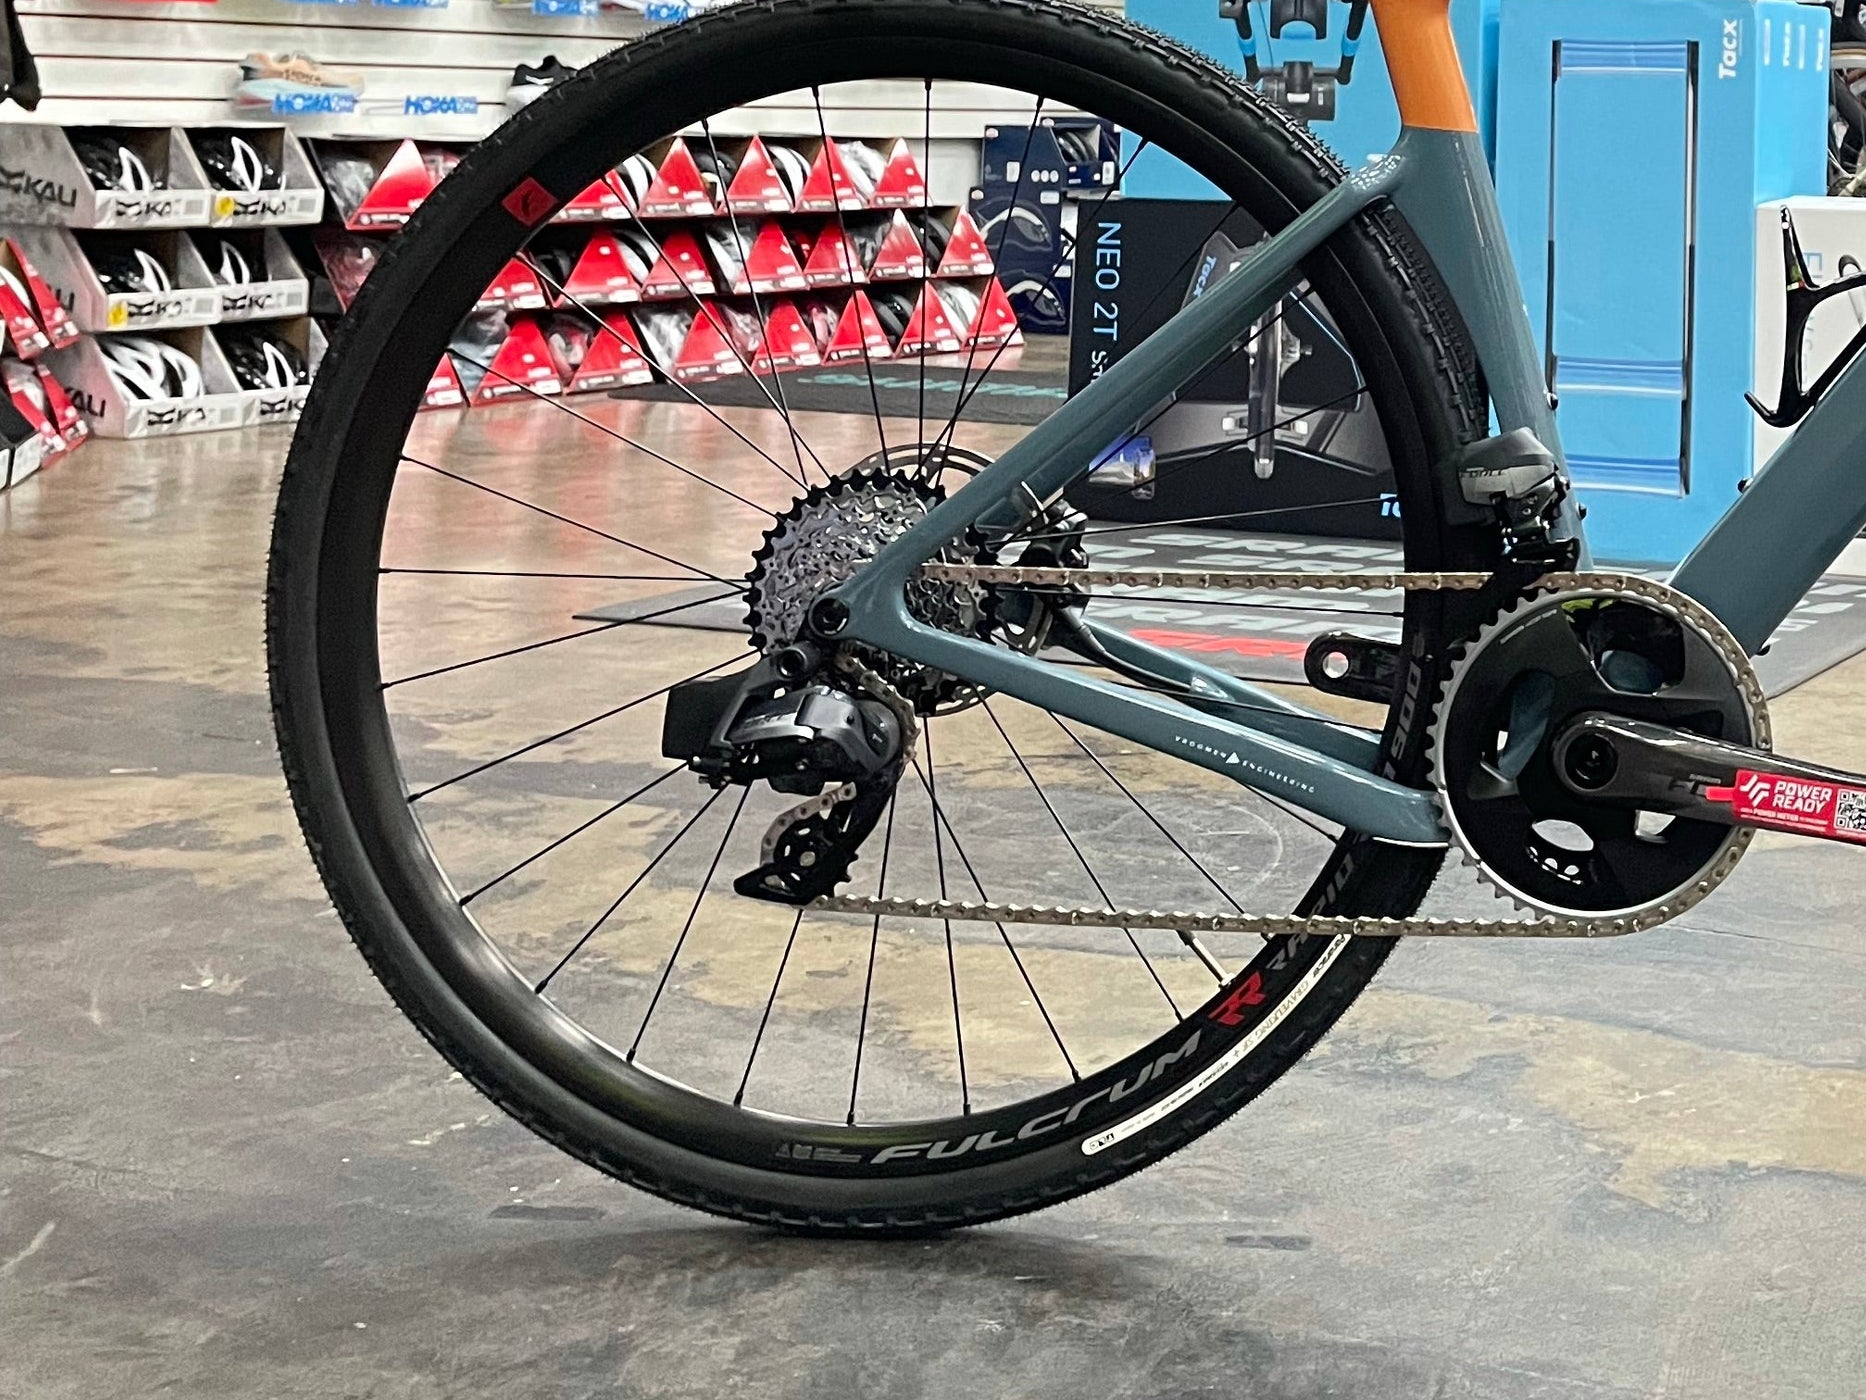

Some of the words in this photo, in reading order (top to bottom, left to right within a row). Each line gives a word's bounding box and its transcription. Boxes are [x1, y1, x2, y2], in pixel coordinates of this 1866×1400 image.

[1718, 18, 1738, 79] Tacx
[24, 177, 77, 208] KALI
[1095, 222, 1121, 290] NEO
[1092, 302, 1119, 341] 2T
[1242, 758, 1316, 794] ENGINEERING
[1774, 781, 1833, 801] POWER
[1772, 794, 1827, 814] READY
[1254, 980, 1309, 1043] GRAVELKING
[870, 1029, 1201, 1164] FULCRUM
